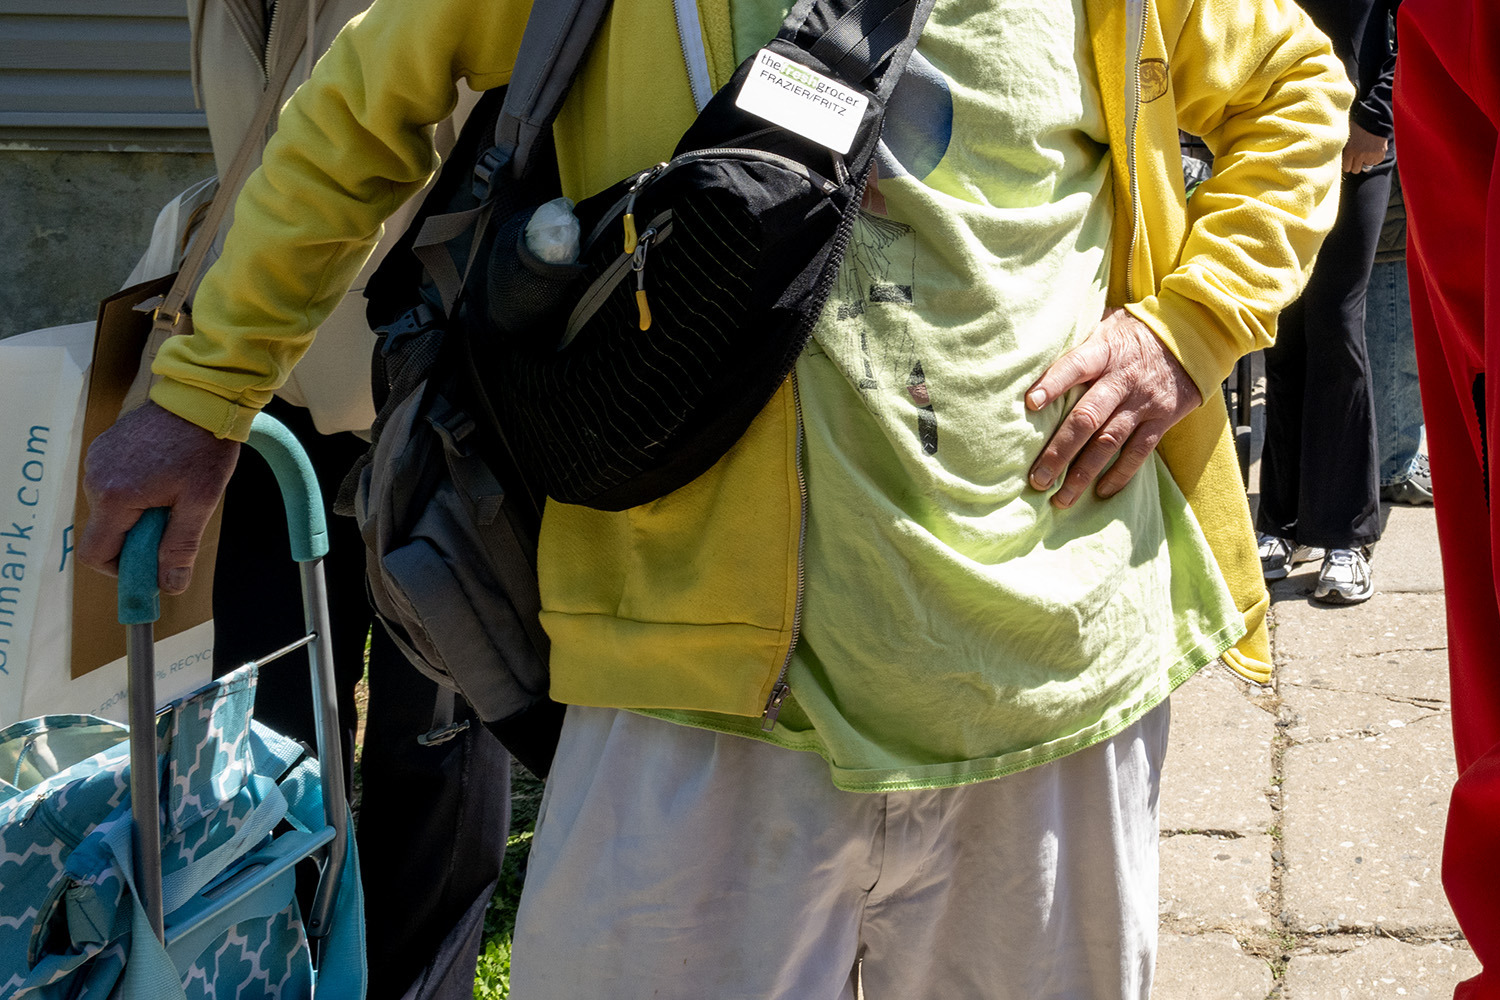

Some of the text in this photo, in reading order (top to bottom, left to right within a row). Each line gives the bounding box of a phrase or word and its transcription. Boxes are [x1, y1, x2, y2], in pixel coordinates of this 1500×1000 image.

[760, 54, 782, 71] the
[815, 82, 860, 107] grocer
[760, 70, 847, 116] FRAZIER/FRITZ
